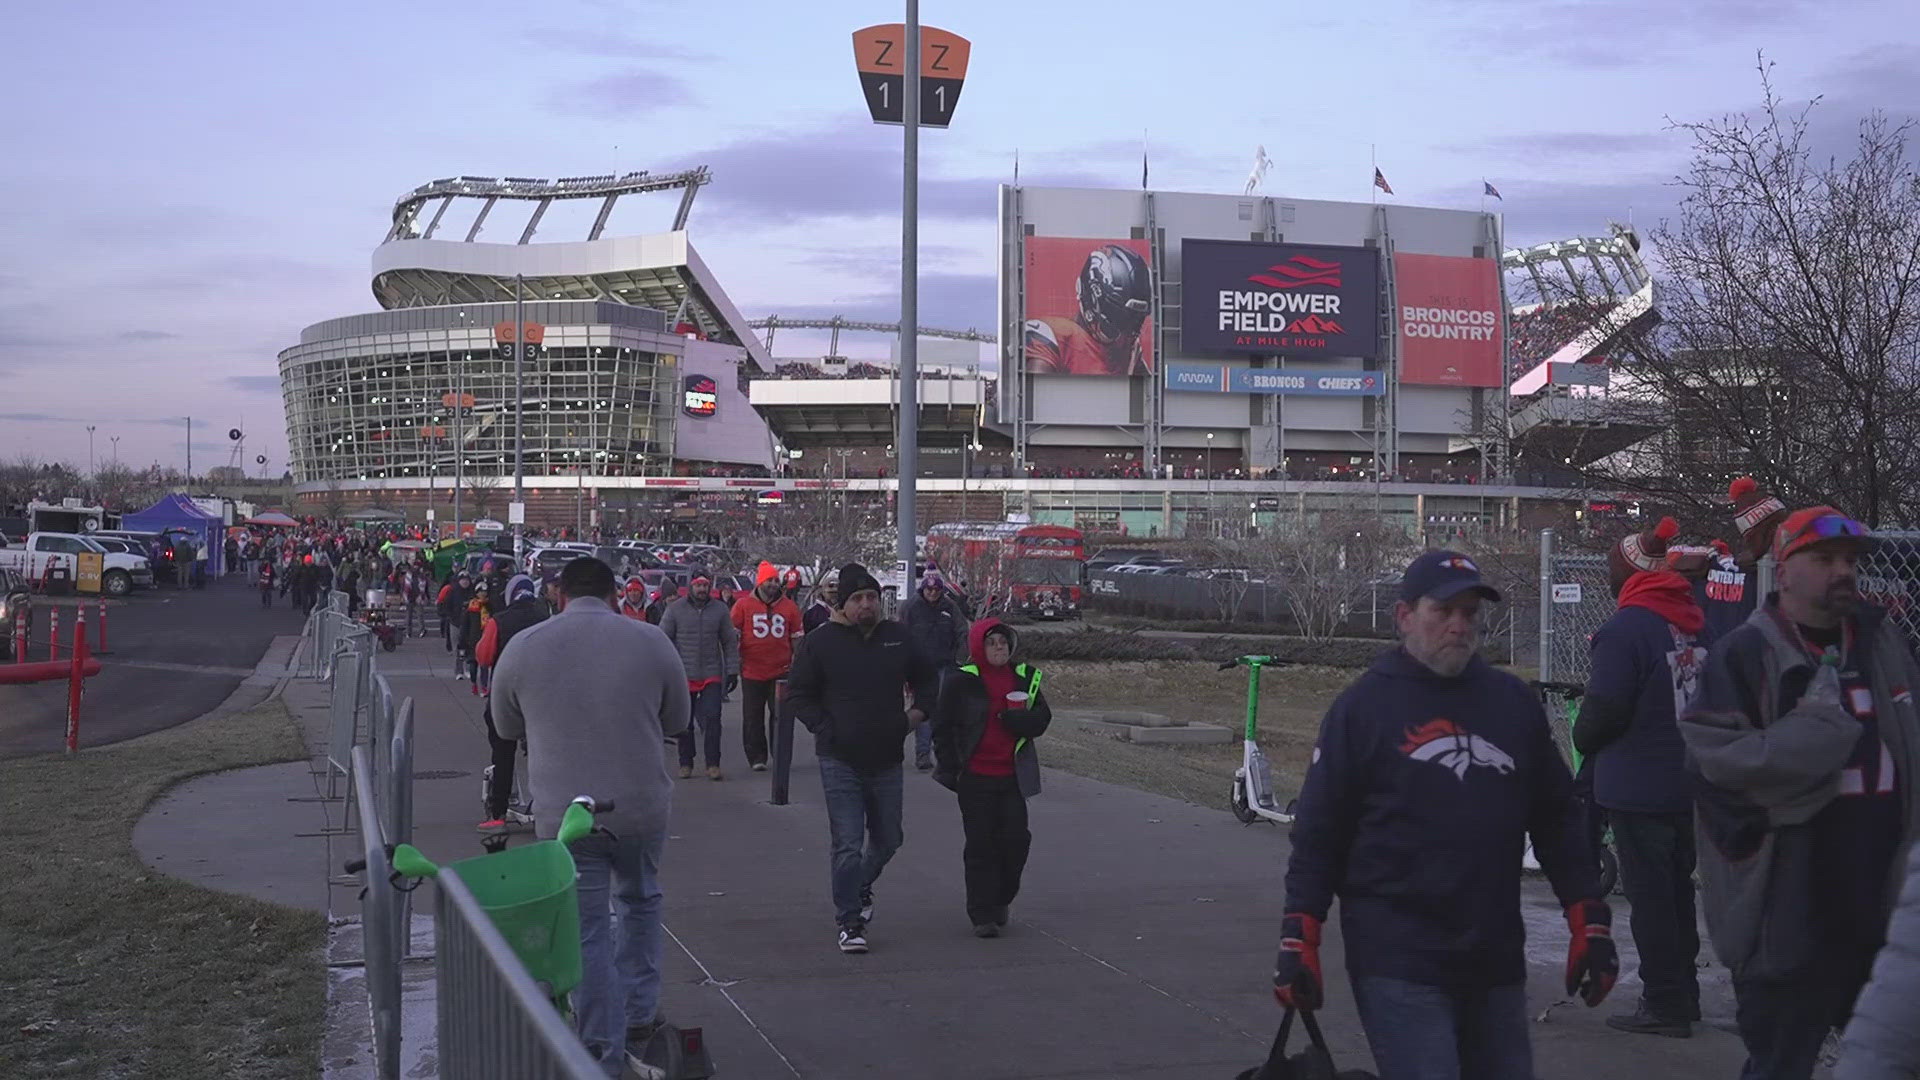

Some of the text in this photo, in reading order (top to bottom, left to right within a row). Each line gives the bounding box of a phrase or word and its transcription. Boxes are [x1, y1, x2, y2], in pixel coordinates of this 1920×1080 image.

[874, 40, 893, 66] Z
[930, 44, 949, 71] Z
[878, 82, 889, 108] 1
[935, 85, 945, 112] 1
[1219, 290, 1341, 314] EMPOWER
[1219, 311, 1286, 333] FIELD
[1402, 306, 1496, 325] BRONCOS
[502, 328, 513, 340] C
[526, 329, 537, 341] C
[1404, 322, 1495, 341] COUNTRY
[503, 344, 512, 357] 3
[526, 345, 536, 358] 3
[1236, 336, 1326, 348] AT MILE HIGH
[1253, 375, 1362, 390] BRONCOS CHIEFS
[448, 407, 454, 415] 2
[463, 408, 469, 416] 2
[1707, 569, 1746, 585] UNITED WE
[1705, 581, 1744, 602] CRUSH
[752, 613, 785, 638] 58
